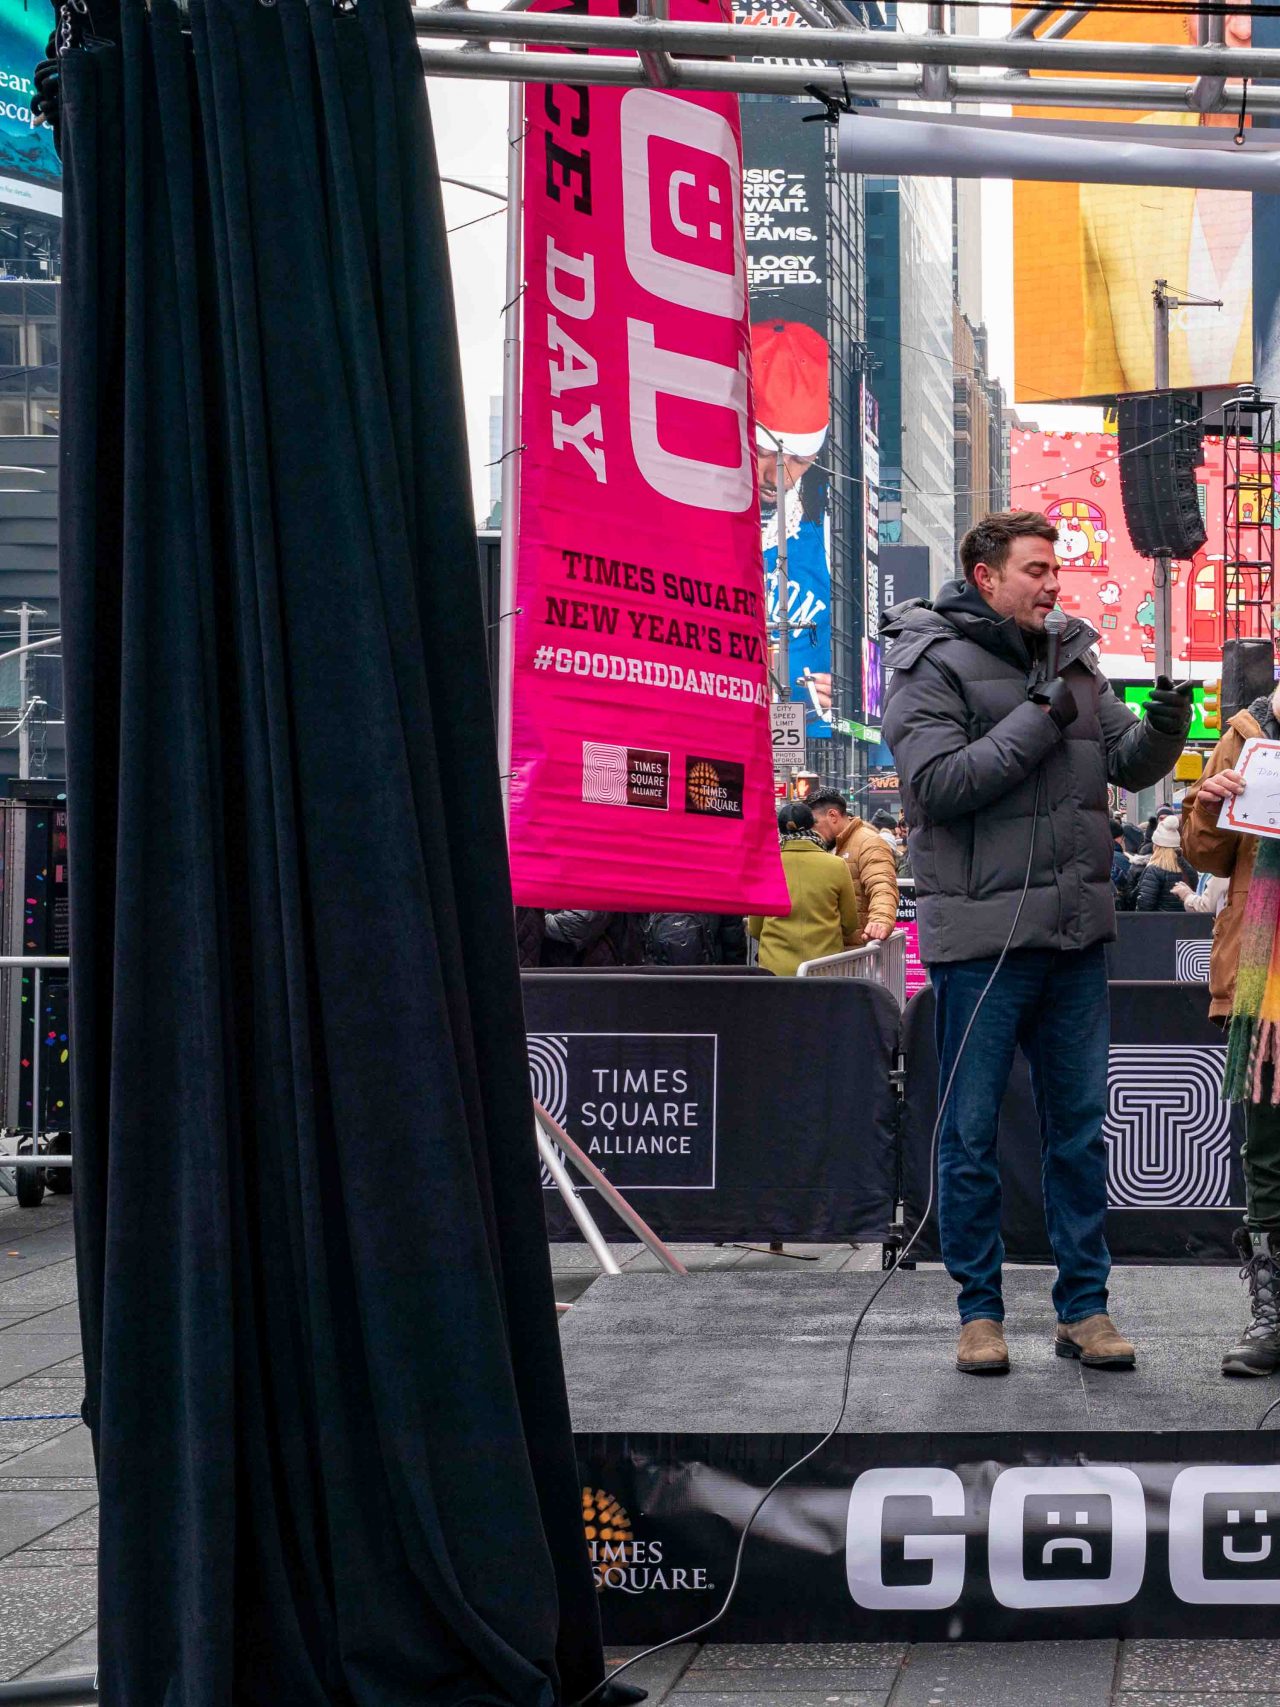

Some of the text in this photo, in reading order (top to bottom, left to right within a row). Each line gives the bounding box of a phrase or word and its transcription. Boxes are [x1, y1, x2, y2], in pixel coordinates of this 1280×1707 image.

[546, 235, 607, 484] DAY
[562, 551, 655, 594] TIMES
[545, 597, 765, 665] NEW YEAR'S EV
[772, 729, 800, 746] 25
[633, 760, 663, 774] TIMES
[630, 773, 665, 787] SQUARE
[632, 786, 663, 798] ALLIANCE
[701, 784, 728, 798] TIMES
[592, 1069, 688, 1094] TIMES
[581, 1102, 699, 1131] SQUARE
[588, 1136, 691, 1154] ALLIANCE
[590, 1540, 663, 1564] IMES
